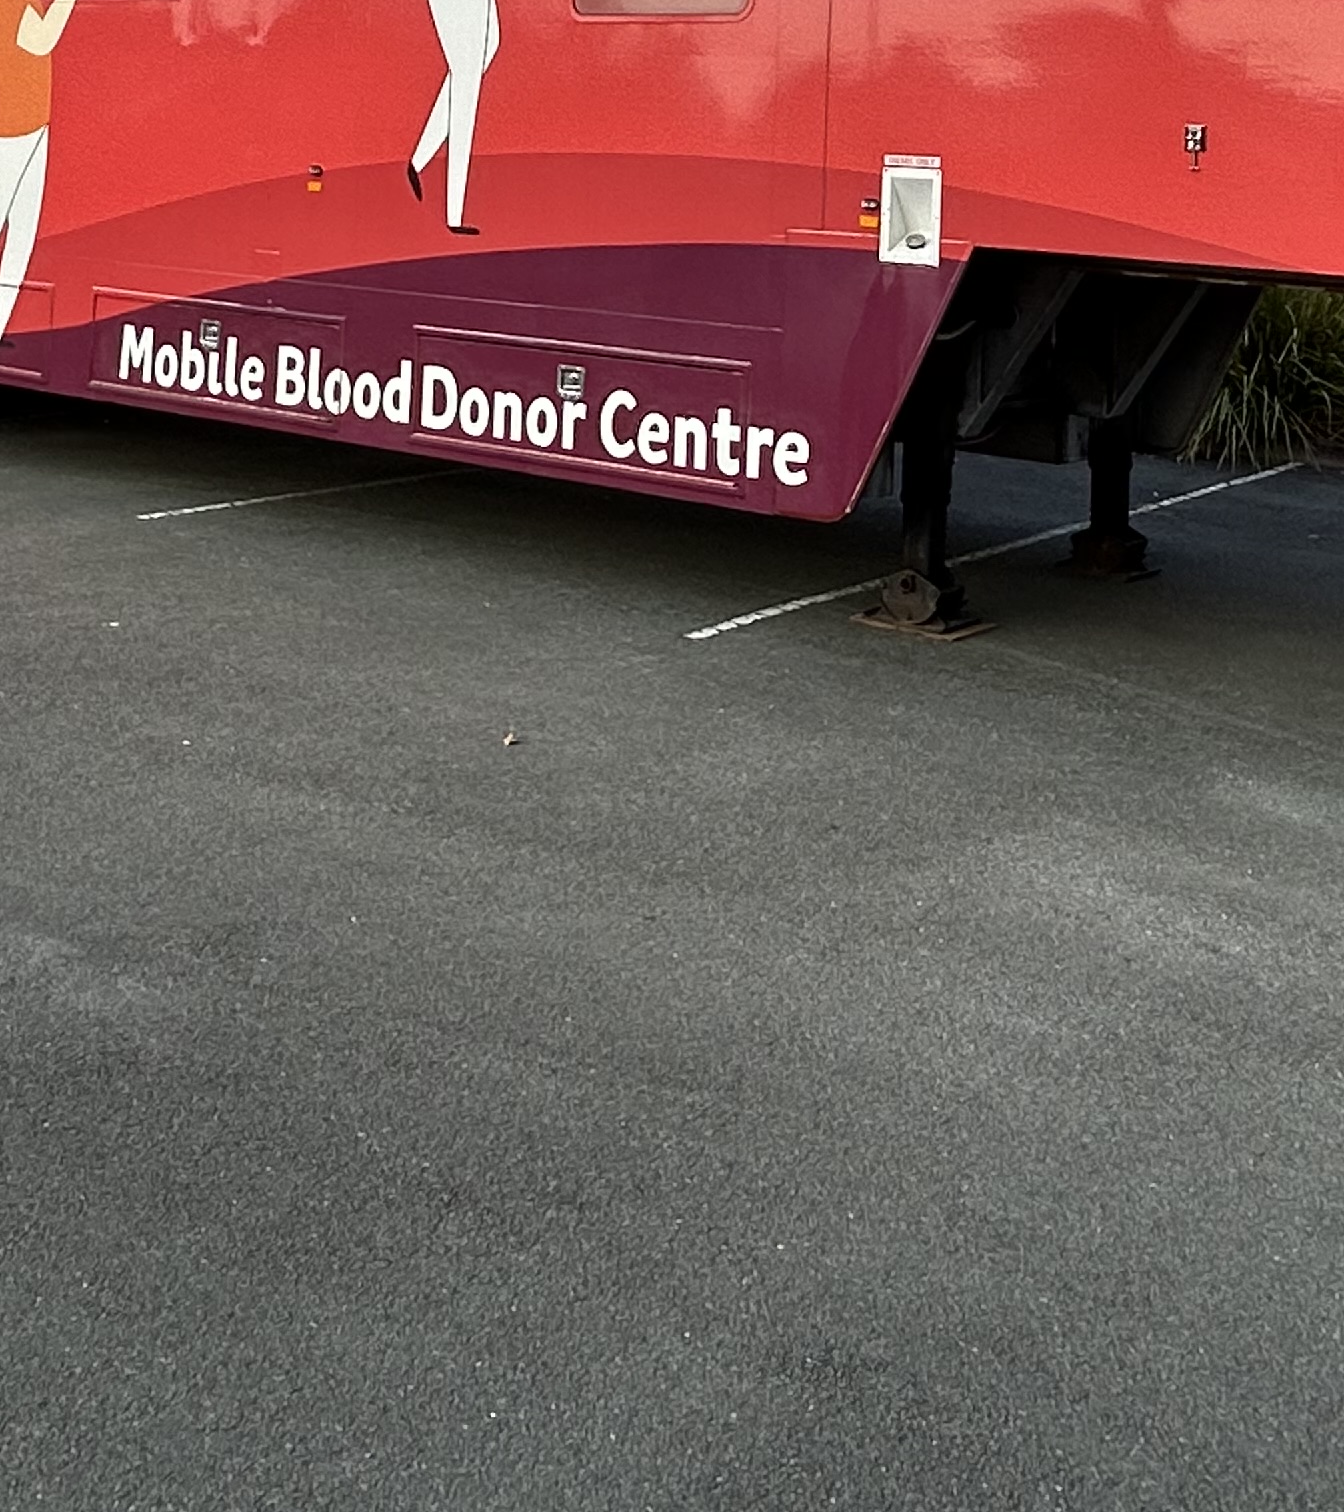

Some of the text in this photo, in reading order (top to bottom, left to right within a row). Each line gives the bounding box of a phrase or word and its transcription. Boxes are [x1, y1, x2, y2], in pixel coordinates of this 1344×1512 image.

[118, 323, 810, 487] Mobile Blood Donor Centre
